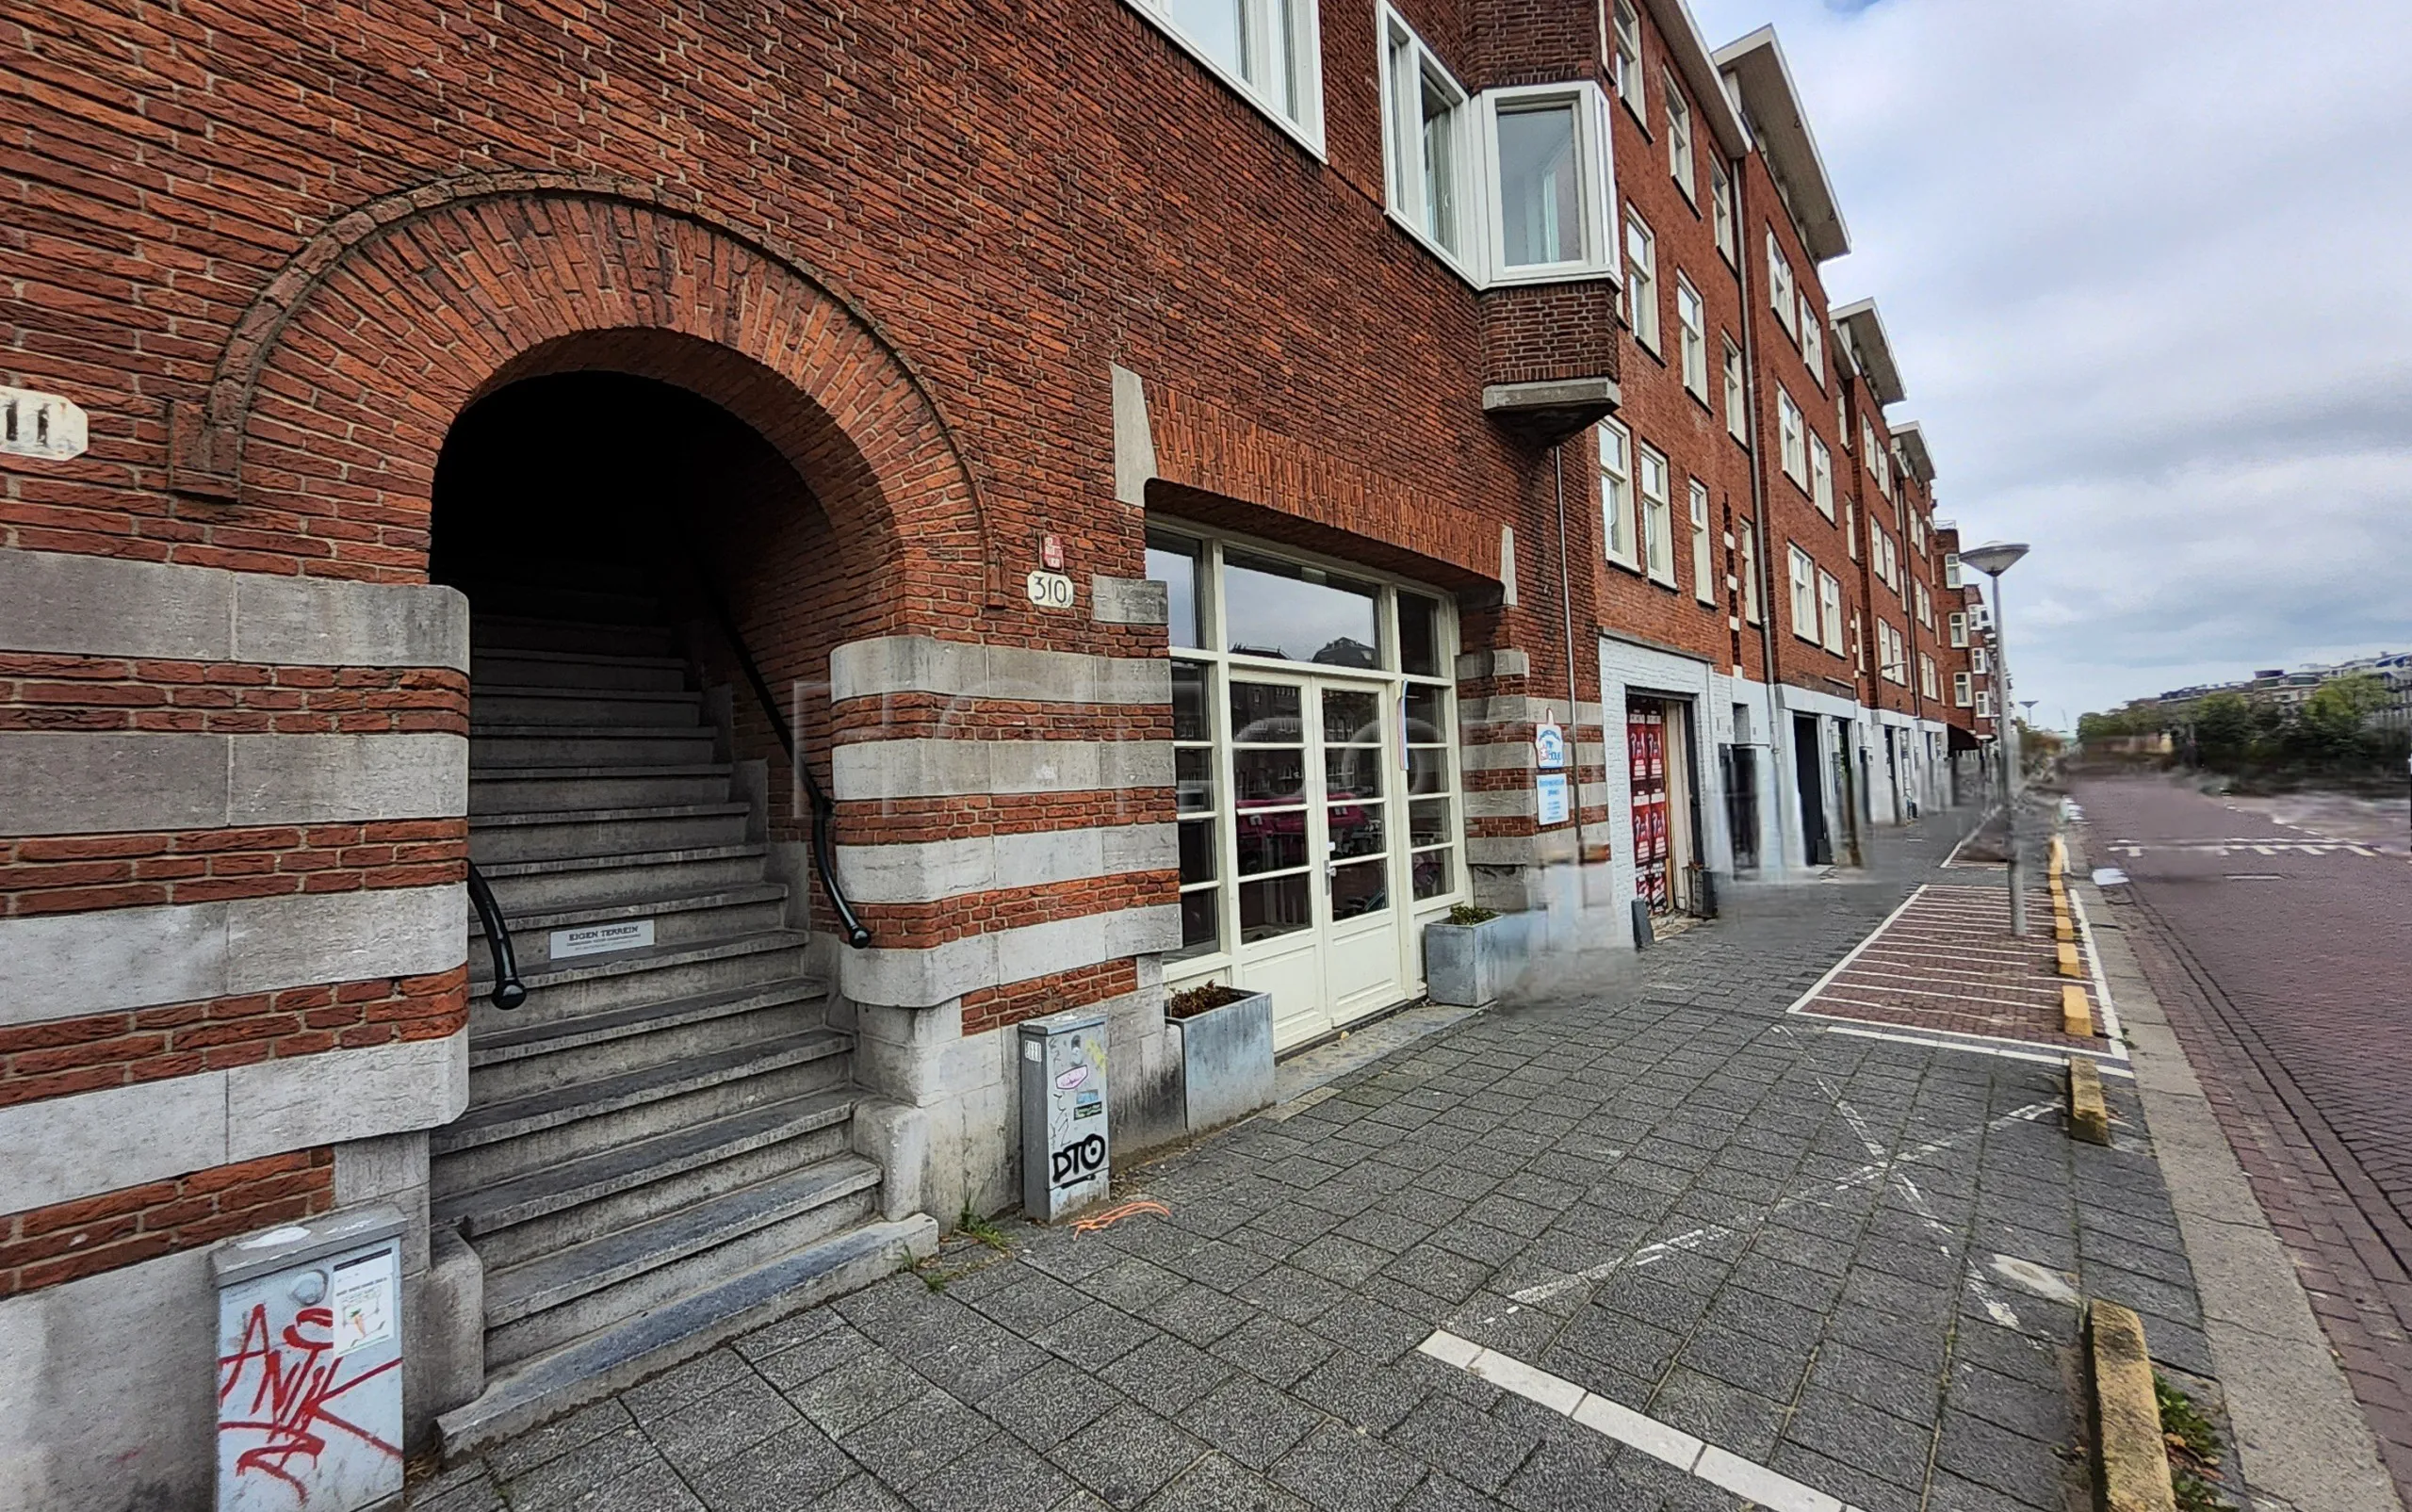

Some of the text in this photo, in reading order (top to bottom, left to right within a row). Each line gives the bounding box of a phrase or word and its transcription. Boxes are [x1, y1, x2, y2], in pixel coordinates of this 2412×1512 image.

[1034, 576, 1067, 603] 310
[569, 931, 597, 940] EIGEN
[600, 926, 638, 936] TERREIN
